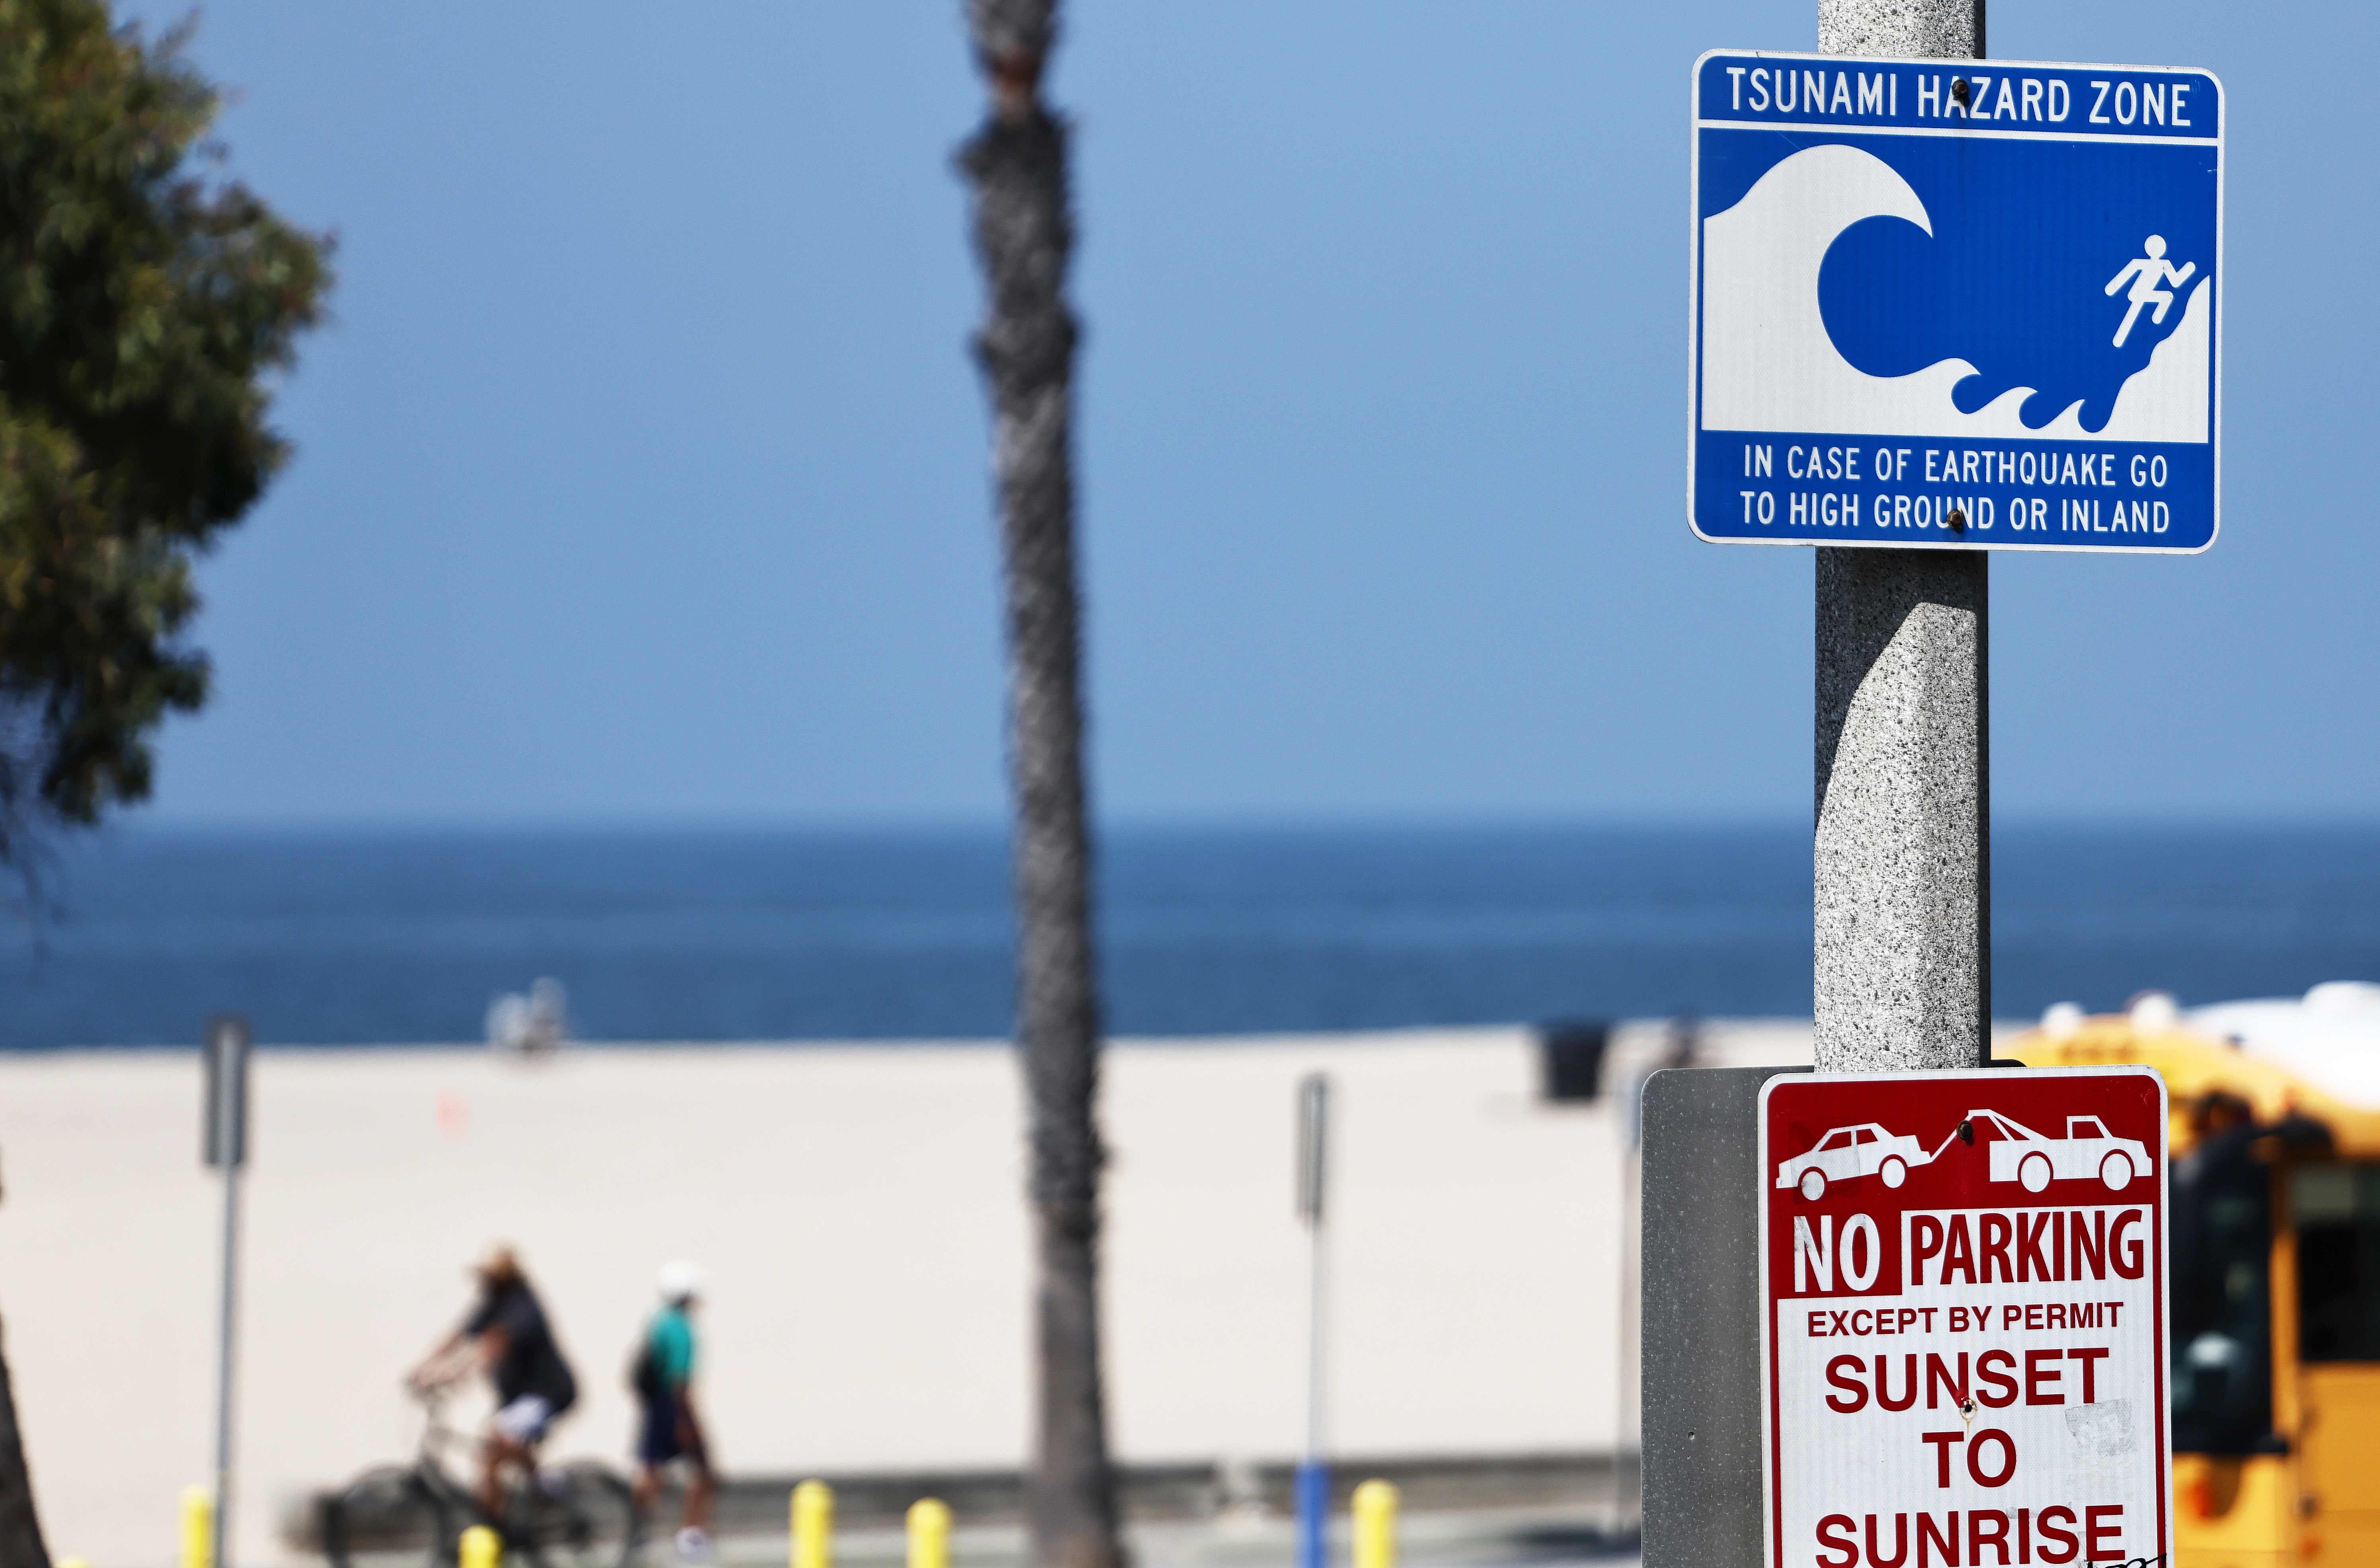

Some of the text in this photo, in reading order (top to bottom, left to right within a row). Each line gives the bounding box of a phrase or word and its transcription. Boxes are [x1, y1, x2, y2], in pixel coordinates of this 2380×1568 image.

[1726, 67, 2191, 126] TSUNAMI HAZARD ZONE
[1745, 444, 2167, 487] IN CASE OF EARTHQUAKE GO
[1740, 491, 2169, 532] TO HIGH GROUND OR INLAND
[1794, 1209, 2144, 1292] NO PARKING
[1808, 1302, 2124, 1337] EXCEPT BY PERMIT
[1825, 1347, 2109, 1414] SUNSET
[1922, 1428, 2016, 1488] TO
[1815, 1504, 2125, 1568] SUNRISE
